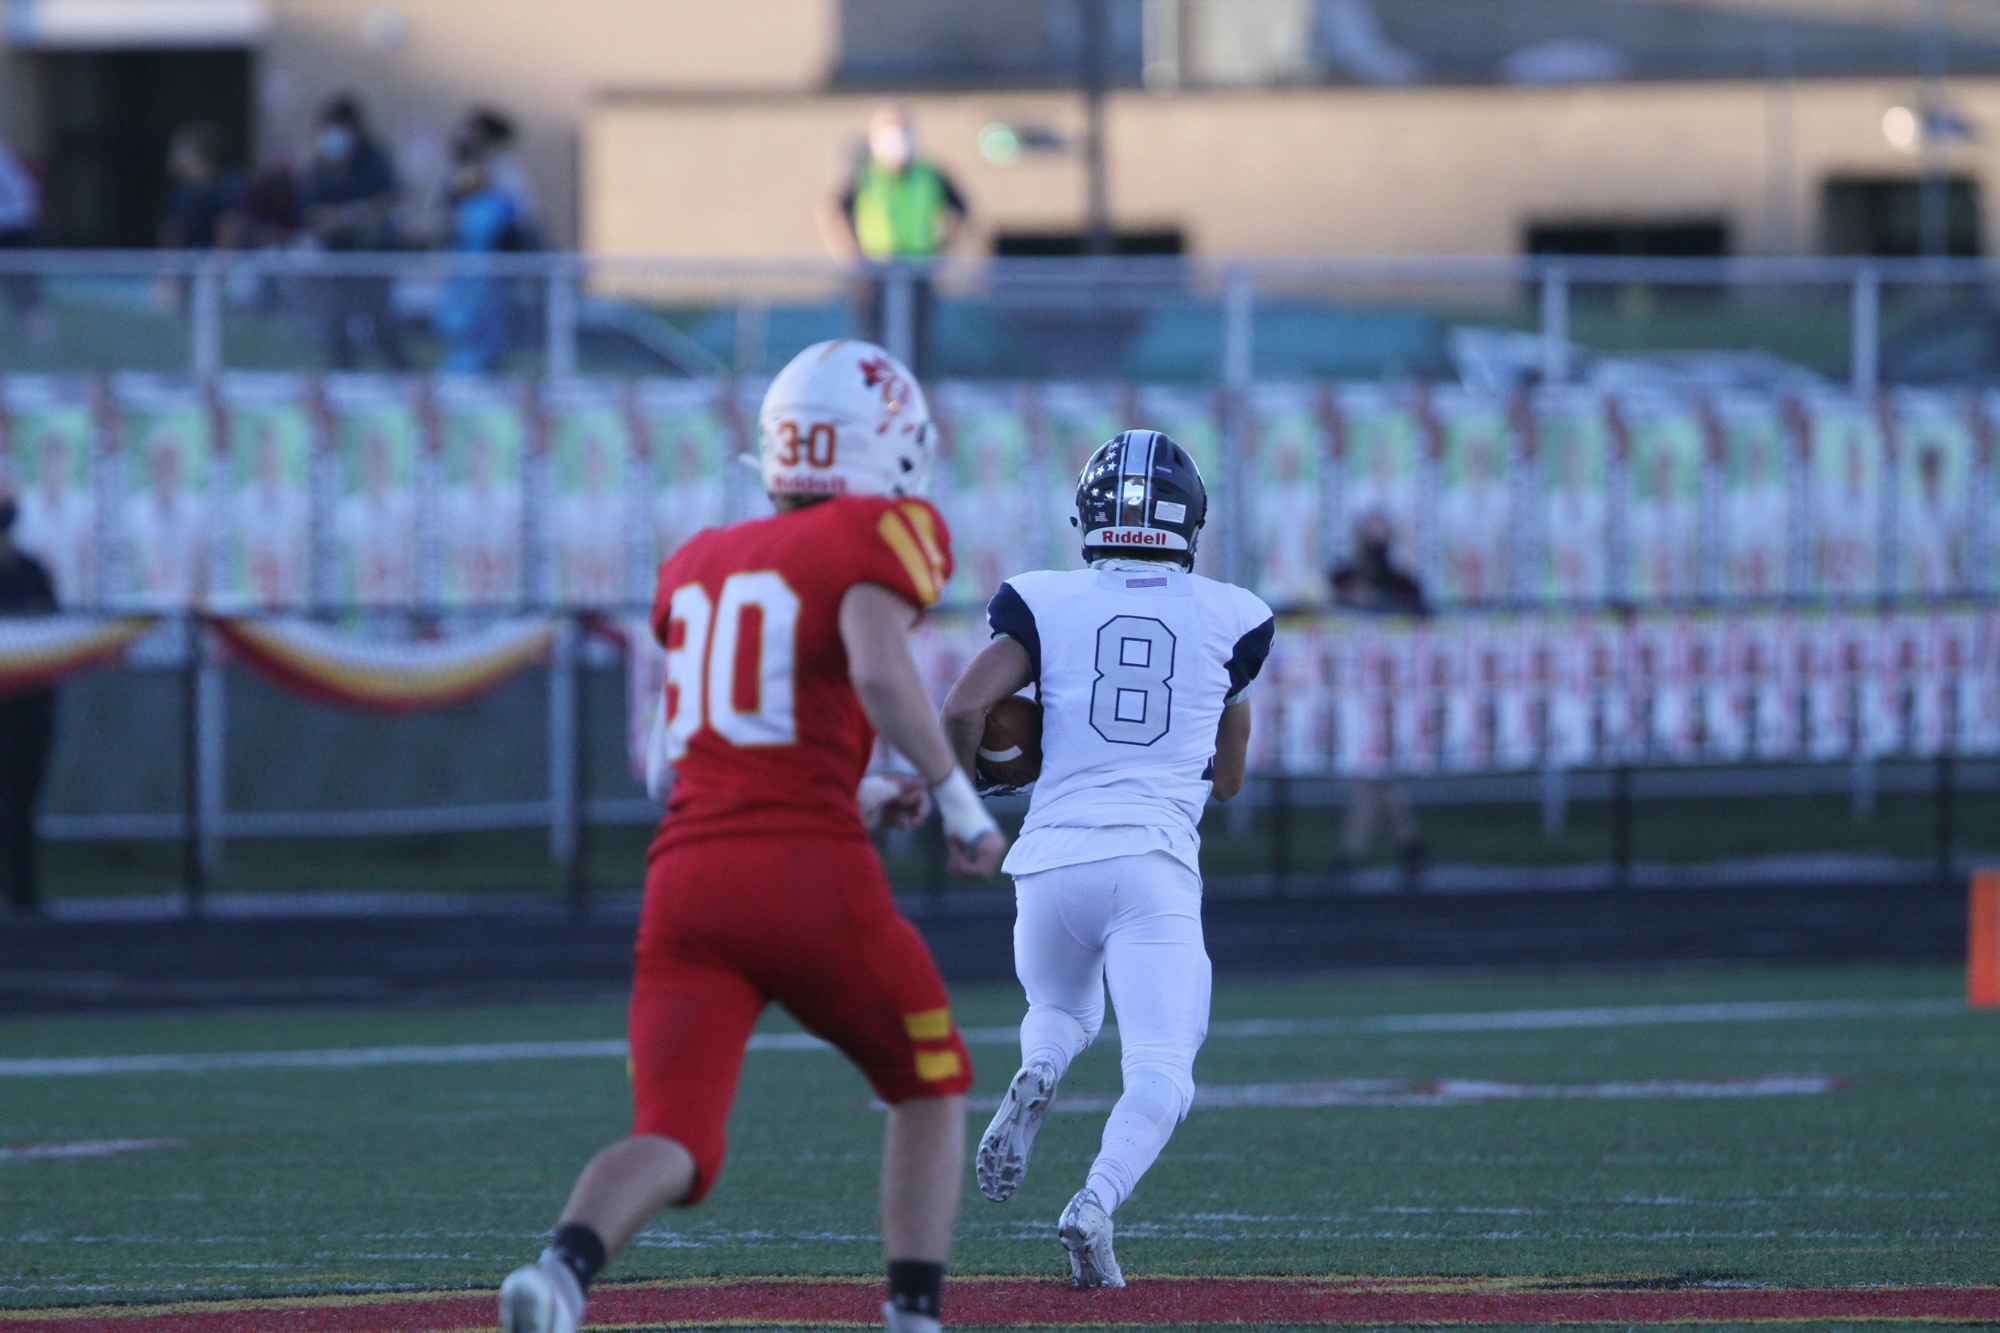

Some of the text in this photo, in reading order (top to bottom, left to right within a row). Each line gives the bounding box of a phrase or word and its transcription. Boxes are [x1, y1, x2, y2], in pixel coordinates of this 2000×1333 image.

[777, 419, 836, 469] 30
[1102, 530, 1166, 545] Riddell
[1089, 614, 1177, 747] 8
